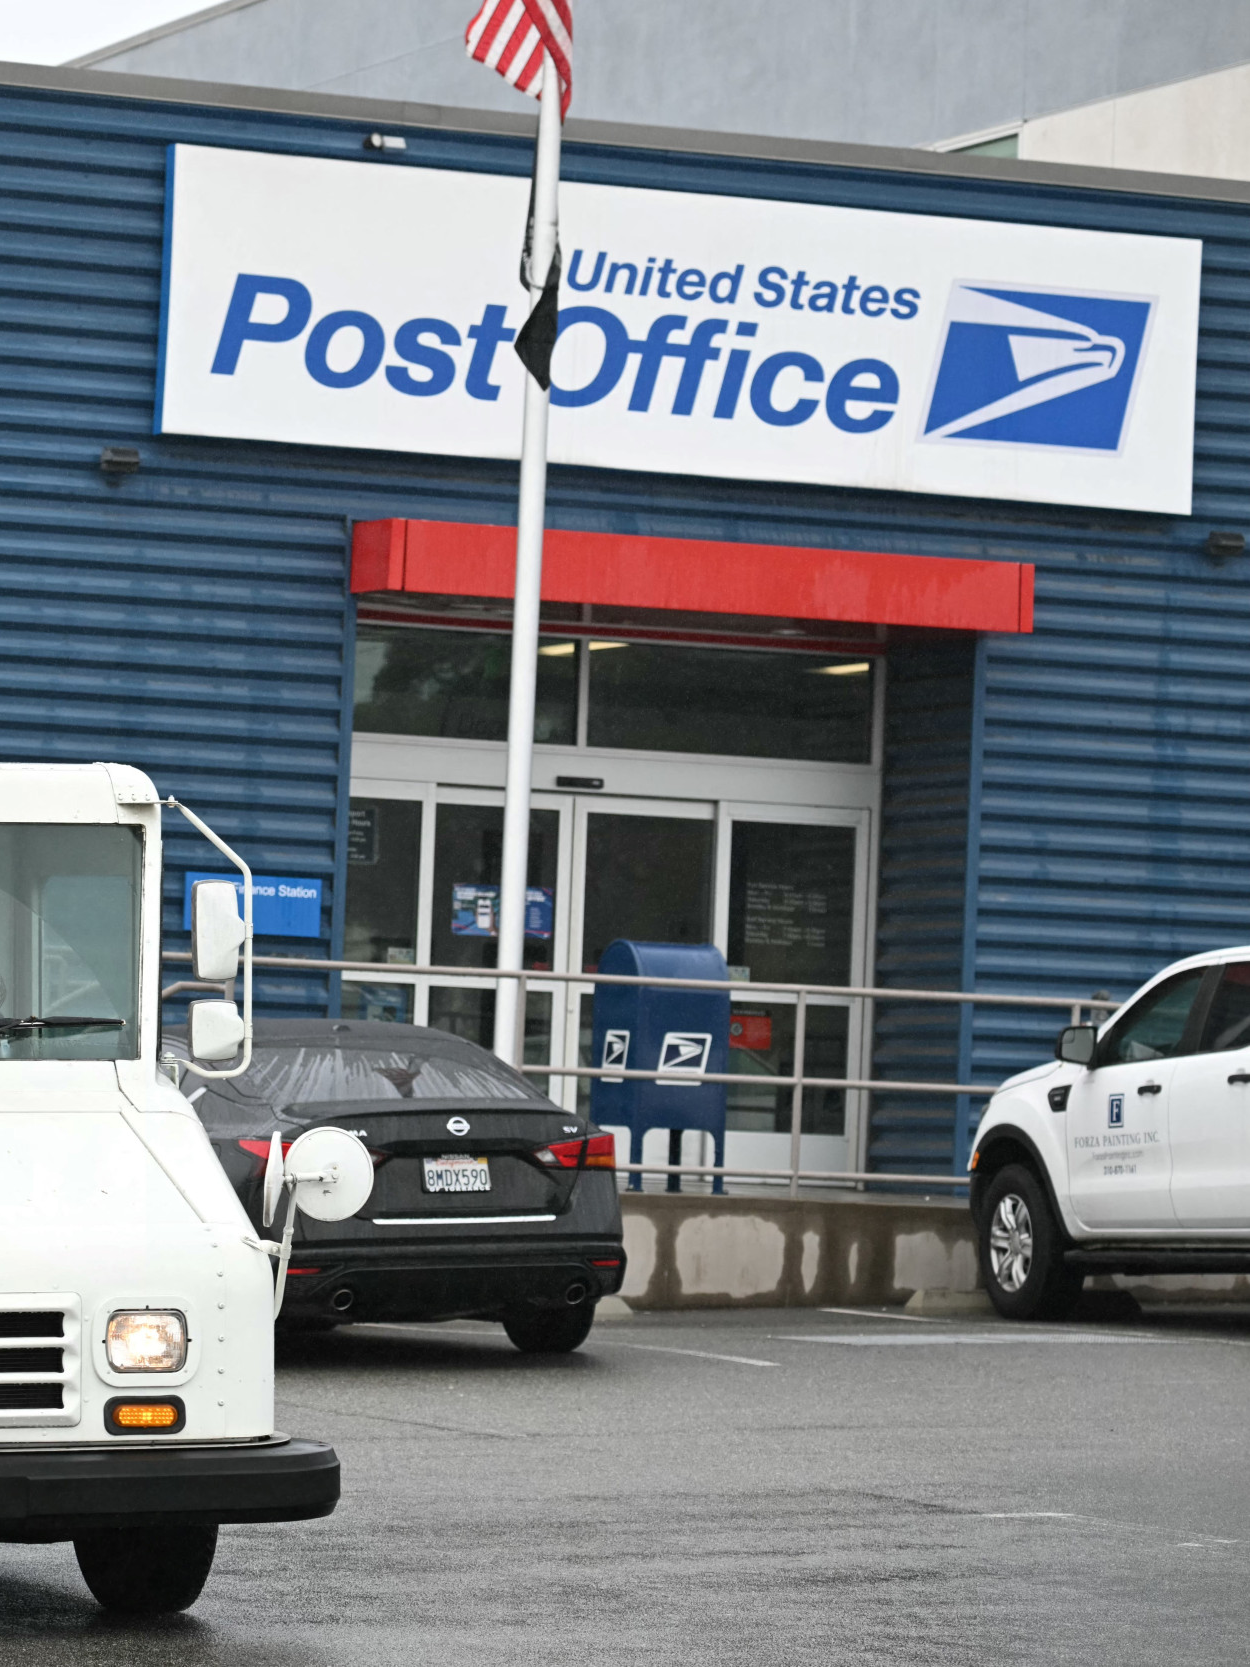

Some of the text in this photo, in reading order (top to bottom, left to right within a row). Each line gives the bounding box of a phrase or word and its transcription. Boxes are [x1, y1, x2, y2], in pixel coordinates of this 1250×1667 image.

[566, 249, 921, 319] United States
[210, 273, 900, 433] Post Office
[278, 885, 317, 899] Station
[1112, 1101, 1120, 1122] F
[562, 1126, 578, 1134] SV
[1074, 1136, 1100, 1148] FORZA
[1102, 1132, 1141, 1147] PAINTING
[427, 1169, 488, 1188] 8MDX590
